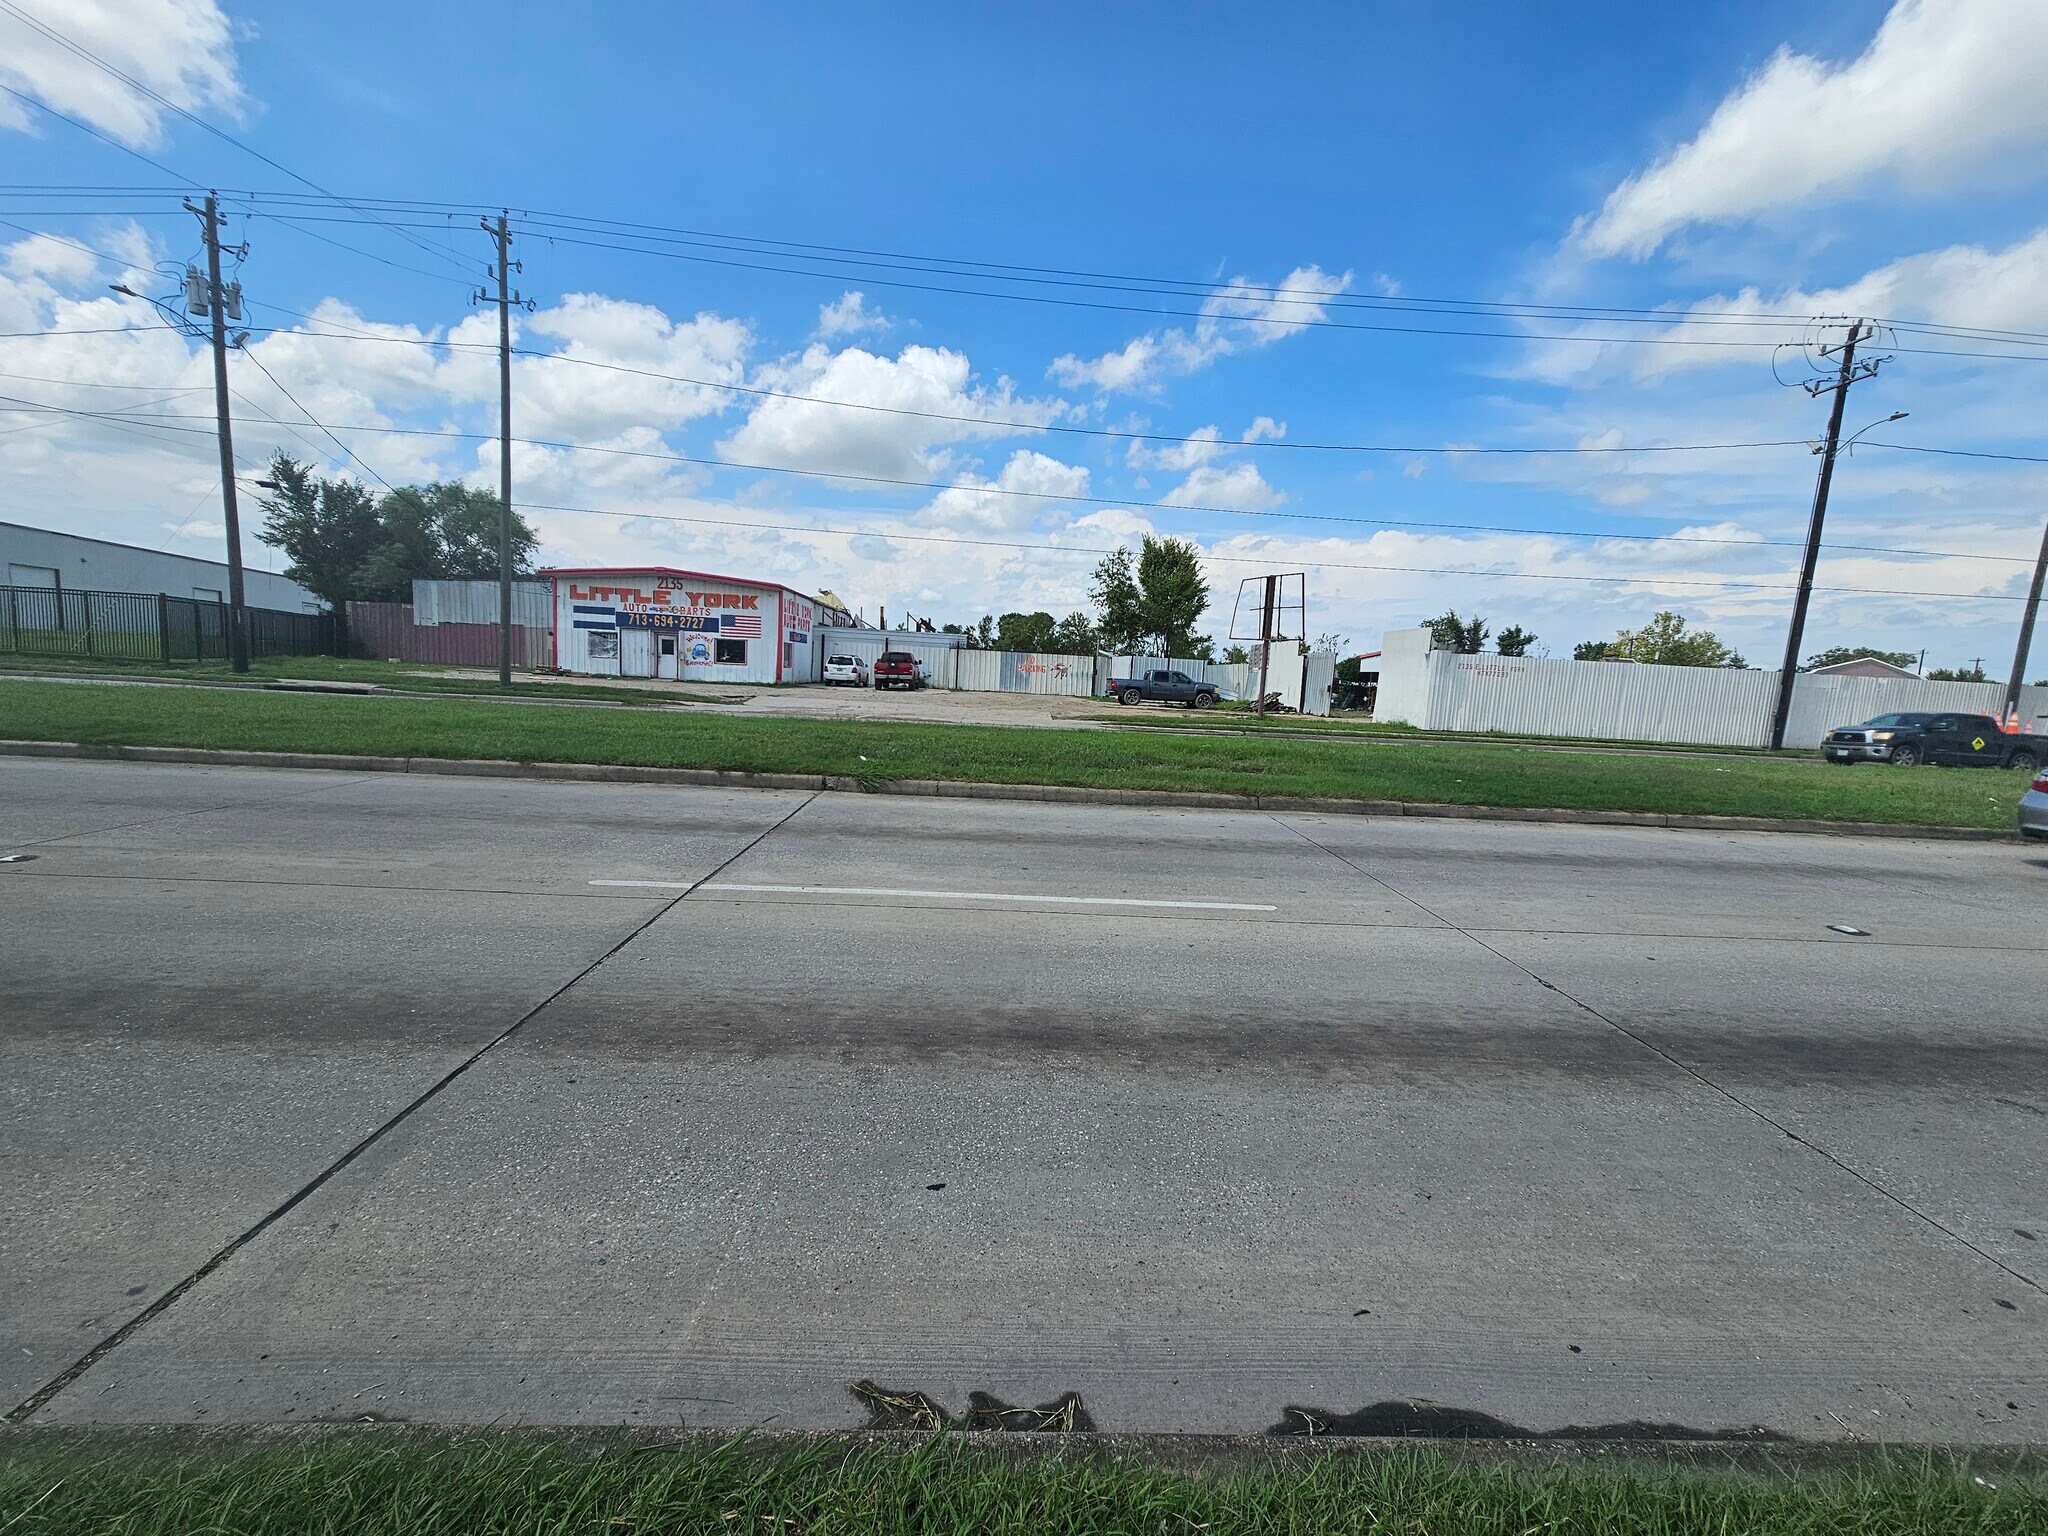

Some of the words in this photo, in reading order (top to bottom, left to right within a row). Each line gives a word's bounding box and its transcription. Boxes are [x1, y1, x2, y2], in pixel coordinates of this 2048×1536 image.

[657, 576, 683, 590] 2135
[570, 584, 671, 605] LITTLE
[685, 591, 759, 610] YORK
[623, 603, 647, 612] AUTO
[680, 606, 711, 616] PARTS
[1017, 664, 1046, 673] PARKING
